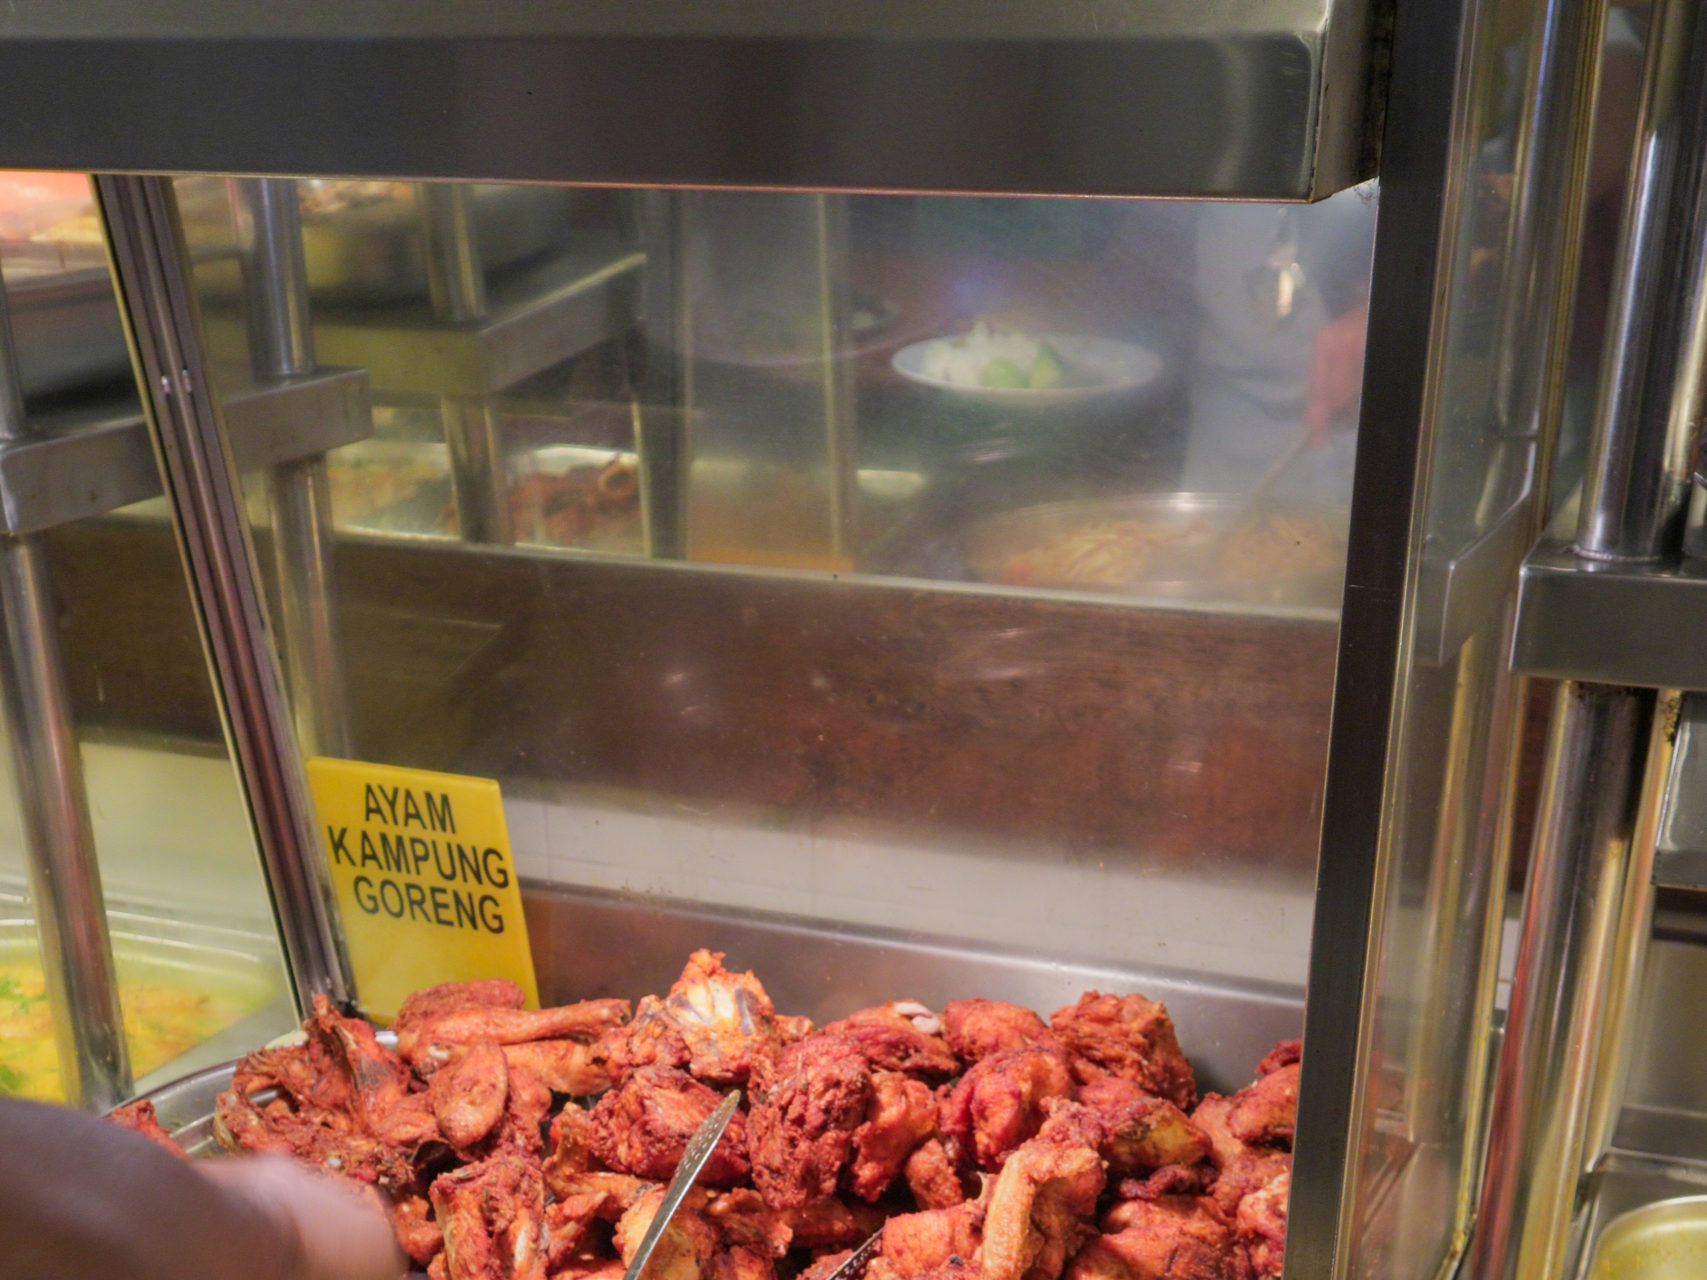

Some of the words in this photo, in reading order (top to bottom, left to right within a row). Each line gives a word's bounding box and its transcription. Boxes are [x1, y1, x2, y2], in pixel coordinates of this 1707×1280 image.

[365, 783, 457, 834] AYAM
[327, 825, 510, 889] KAMPUNG
[353, 875, 505, 935] GORENG
